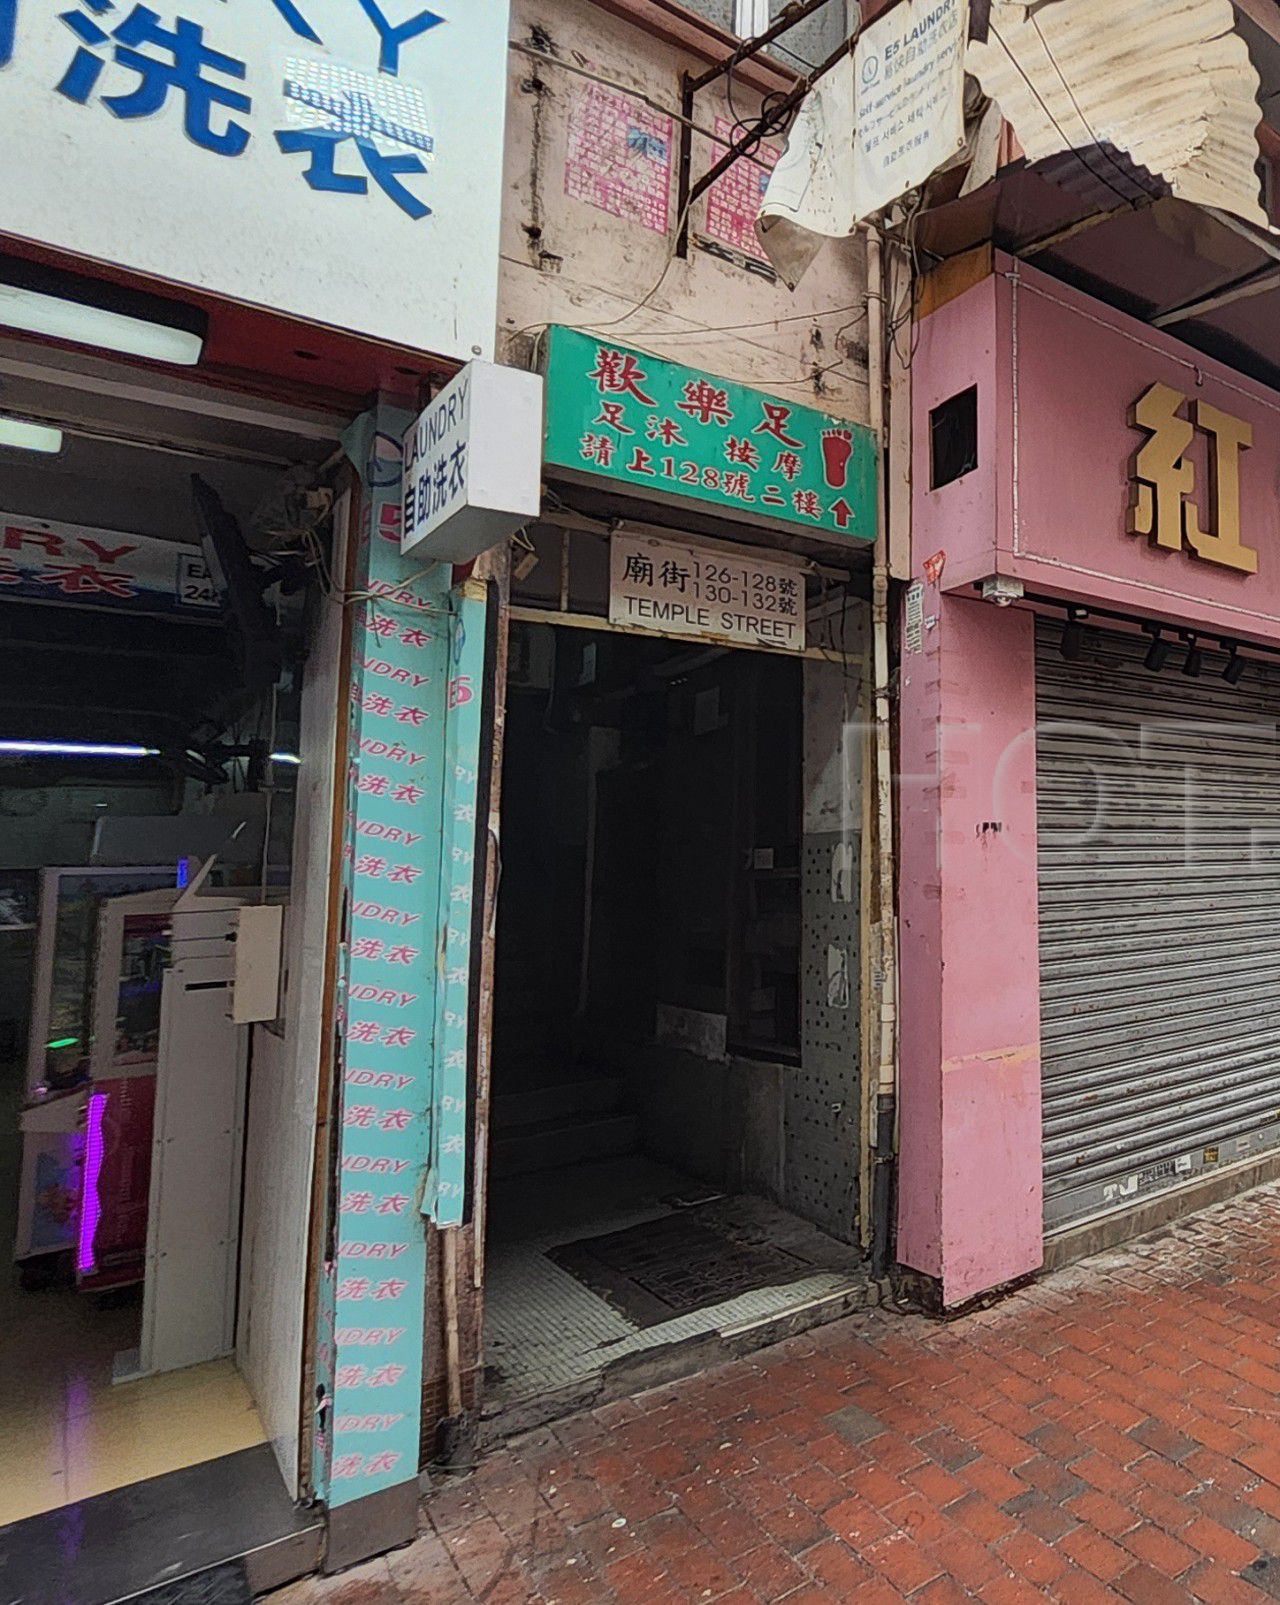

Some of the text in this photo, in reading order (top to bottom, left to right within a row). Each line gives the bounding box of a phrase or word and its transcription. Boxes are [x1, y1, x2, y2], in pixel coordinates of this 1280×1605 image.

[404, 378, 469, 473] LAUNDRY
[587, 345, 805, 450] 歡樂足
[404, 439, 467, 539] 自助洗衣
[622, 552, 690, 594] 廟街
[623, 595, 797, 640] TEMPLE STREET
